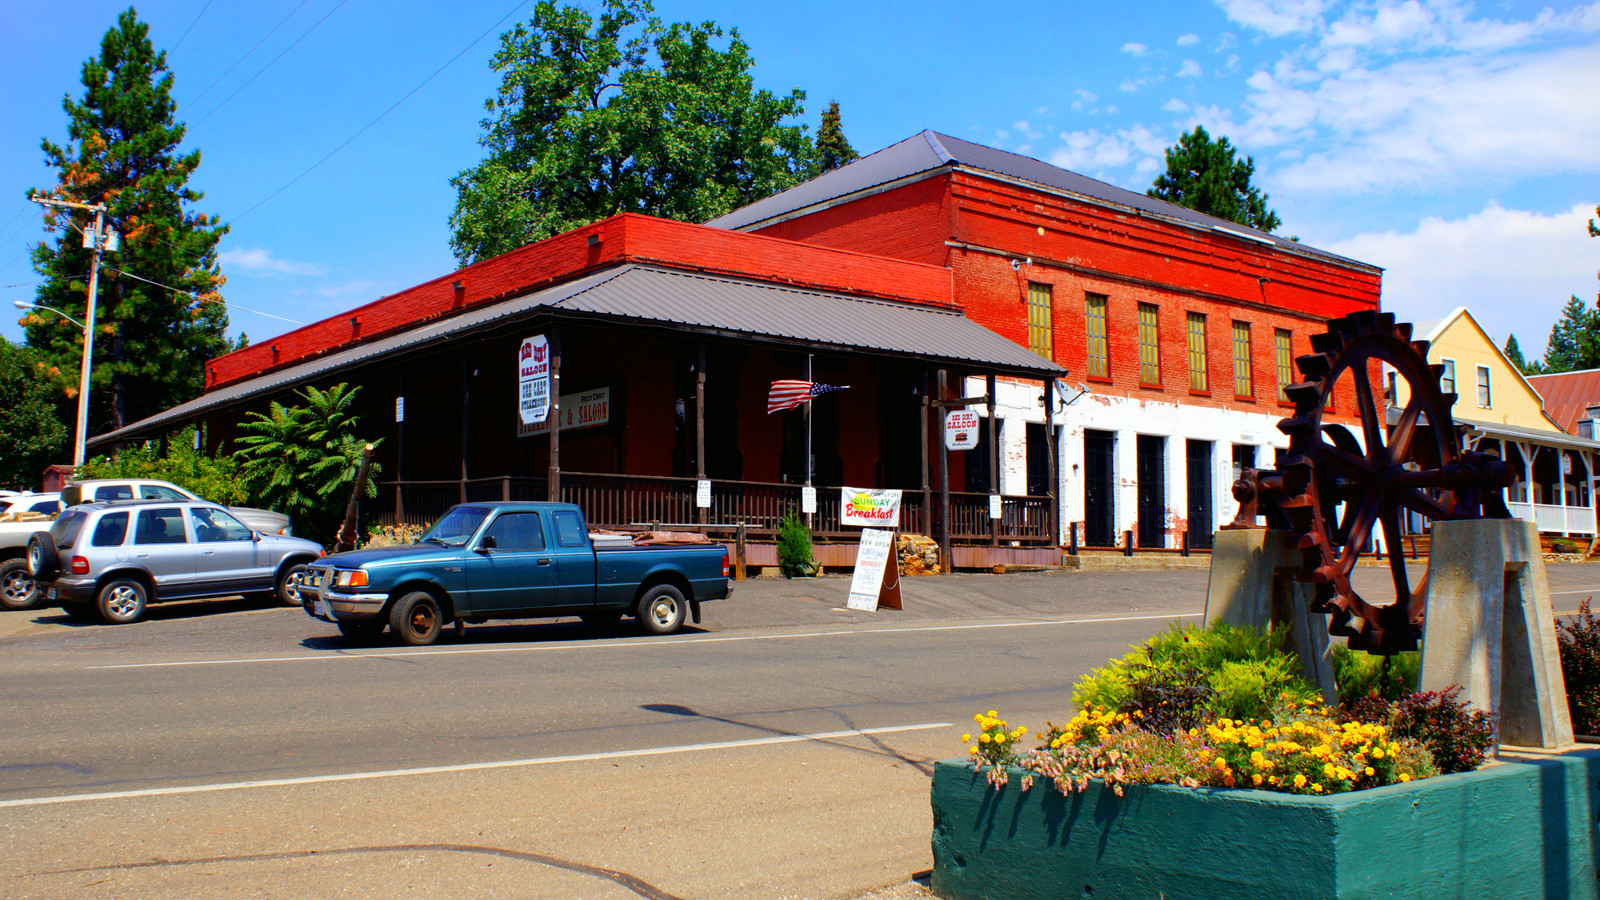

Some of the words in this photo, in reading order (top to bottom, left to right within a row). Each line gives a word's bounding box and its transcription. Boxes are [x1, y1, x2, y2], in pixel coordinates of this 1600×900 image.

[521, 342, 532, 362] RED
[534, 342, 547, 362] DIRT
[521, 363, 548, 376] SALOON
[567, 408, 573, 426] &
[579, 402, 607, 424] SALOON
[947, 420, 976, 429] SALOON
[854, 498, 890, 506] SUNDAY
[846, 503, 893, 519] Breakfast
